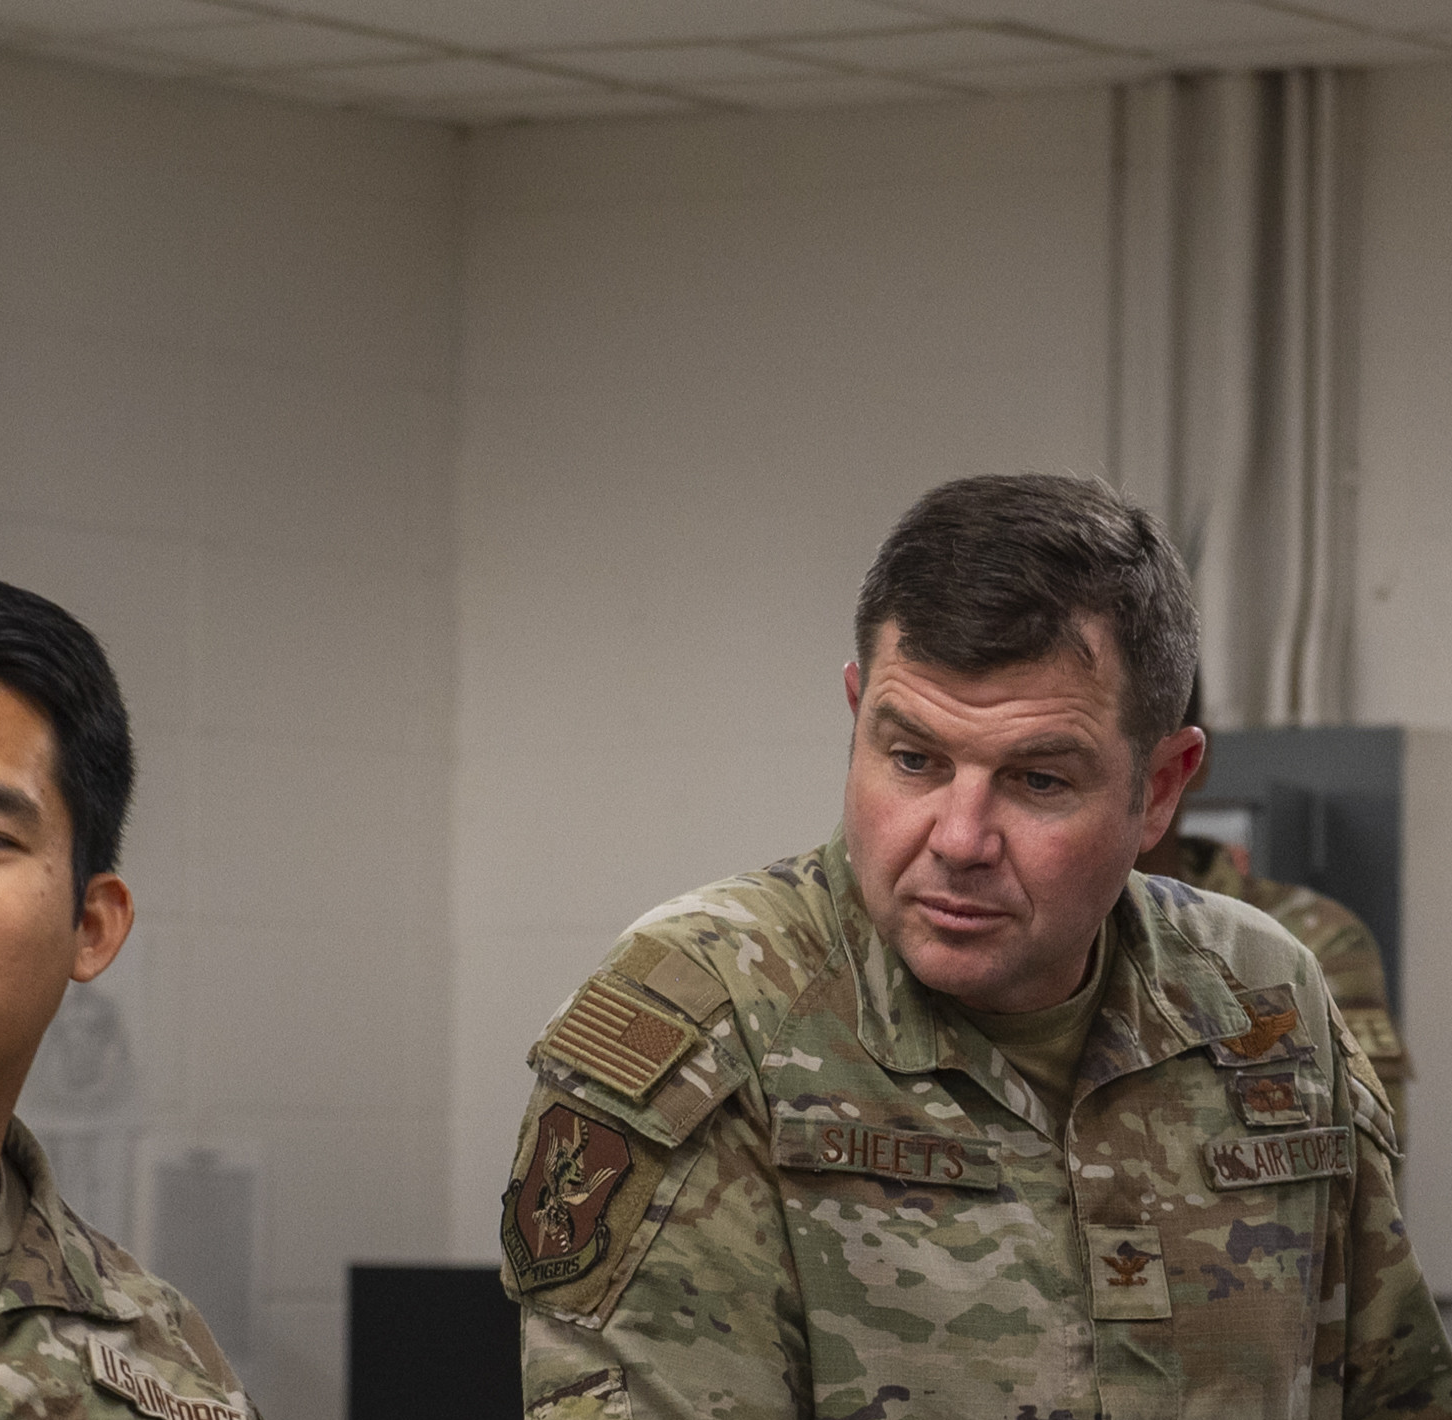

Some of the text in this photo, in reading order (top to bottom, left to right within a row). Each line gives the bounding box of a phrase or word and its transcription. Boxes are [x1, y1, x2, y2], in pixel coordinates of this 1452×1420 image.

[822, 1126, 964, 1180] SHEETS
[1253, 1141, 1288, 1178] AIR
[1285, 1134, 1347, 1175] FORCE
[531, 1256, 581, 1282] TIGERS
[135, 1376, 170, 1419] AIR
